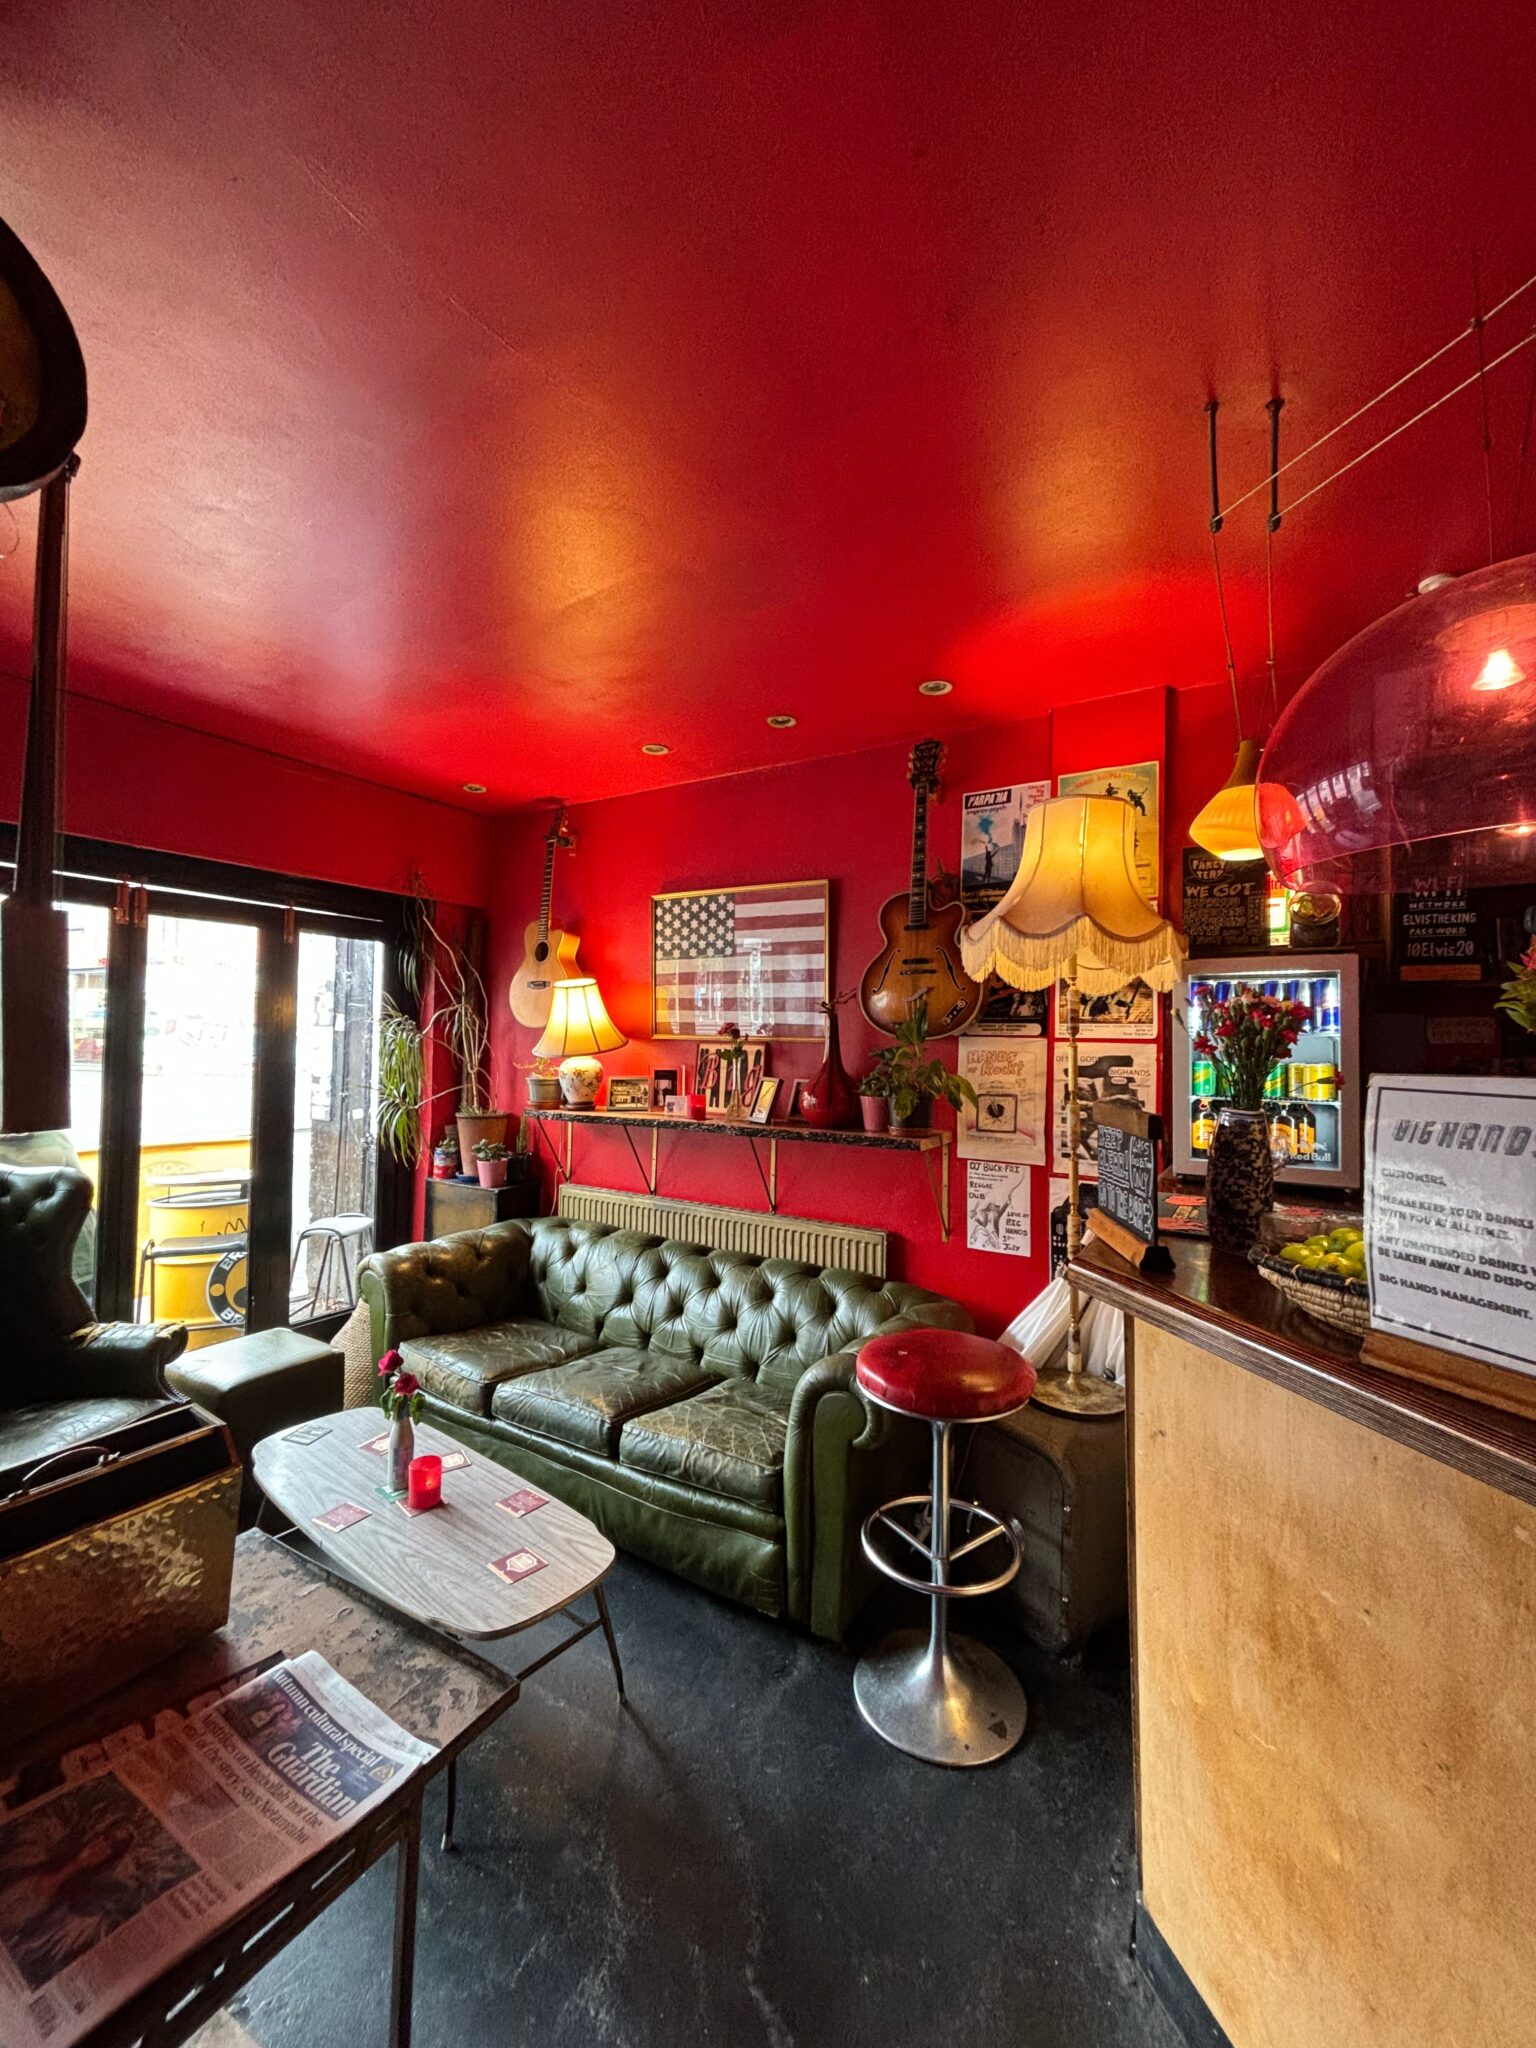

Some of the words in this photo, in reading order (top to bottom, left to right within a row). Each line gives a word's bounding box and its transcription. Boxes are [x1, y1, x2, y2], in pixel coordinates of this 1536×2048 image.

[1185, 885, 1209, 897] WE
[1408, 900, 1467, 909] NETWORK
[1402, 912, 1477, 926] ELVISTHEKING
[966, 1049, 1018, 1064] HANDS
[969, 1161, 982, 1171] DJ
[1311, 1152, 1332, 1162] Bull
[1379, 1207, 1407, 1221] WITH
[1409, 1213, 1431, 1225] YOU
[1451, 1221, 1472, 1233] ALL
[1419, 1200, 1447, 1213] KEEP
[1450, 1207, 1482, 1221] YOUR
[1485, 1212, 1534, 1230] DRINKS
[1377, 1246, 1391, 1258] BE
[1392, 1249, 1427, 1266] TAKEN
[1429, 1258, 1461, 1274] AWAY
[1463, 1267, 1491, 1281] AND
[1378, 1235, 1401, 1247] ANY
[1402, 1238, 1476, 1263] UNATTENDED
[1479, 1255, 1528, 1275] DRINKS
[1379, 1273, 1399, 1285] BIG
[1400, 1278, 1439, 1296] HANDS
[1440, 1288, 1534, 1321] MANAGEMENT.
[272, 1668, 311, 1707] Autumn
[305, 1706, 348, 1742] cultural
[339, 1738, 380, 1768] special
[301, 1742, 340, 1778] The
[242, 1759, 290, 1802] Hezbollah
[302, 1809, 322, 1828] the
[267, 1742, 355, 1816] Guardian
[241, 1786, 261, 1807] says
[259, 1800, 309, 1844] Netanyahu
